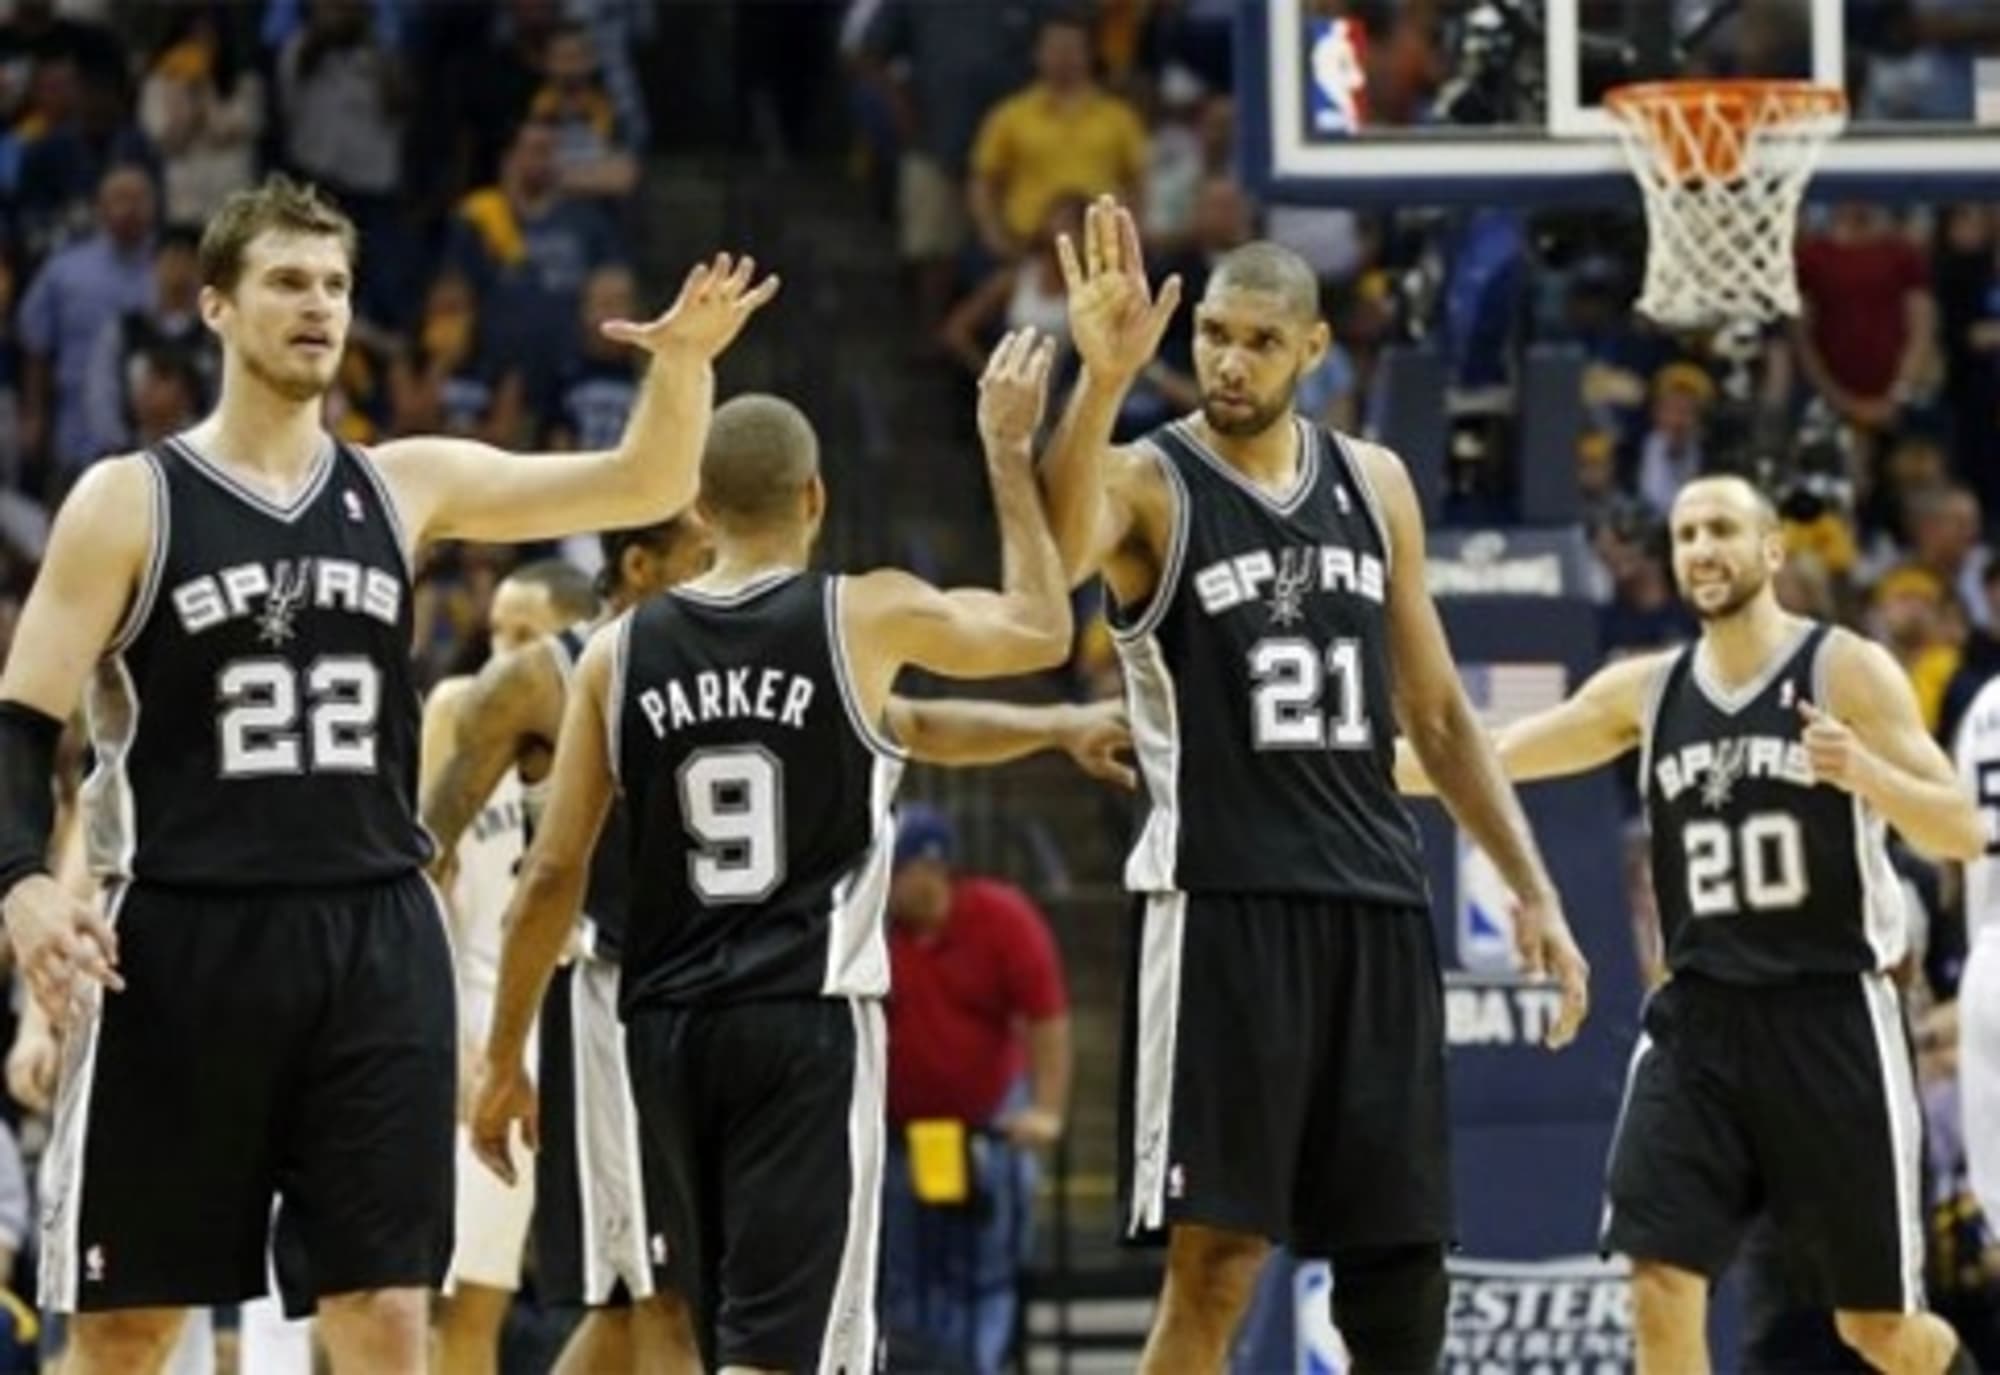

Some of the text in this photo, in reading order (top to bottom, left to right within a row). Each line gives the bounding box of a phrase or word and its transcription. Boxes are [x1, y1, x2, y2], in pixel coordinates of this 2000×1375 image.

[218, 656, 382, 778] 22
[639, 666, 815, 739] PARKER
[1249, 636, 1373, 750] 21
[677, 743, 787, 904] 9
[1682, 812, 1810, 918] 20
